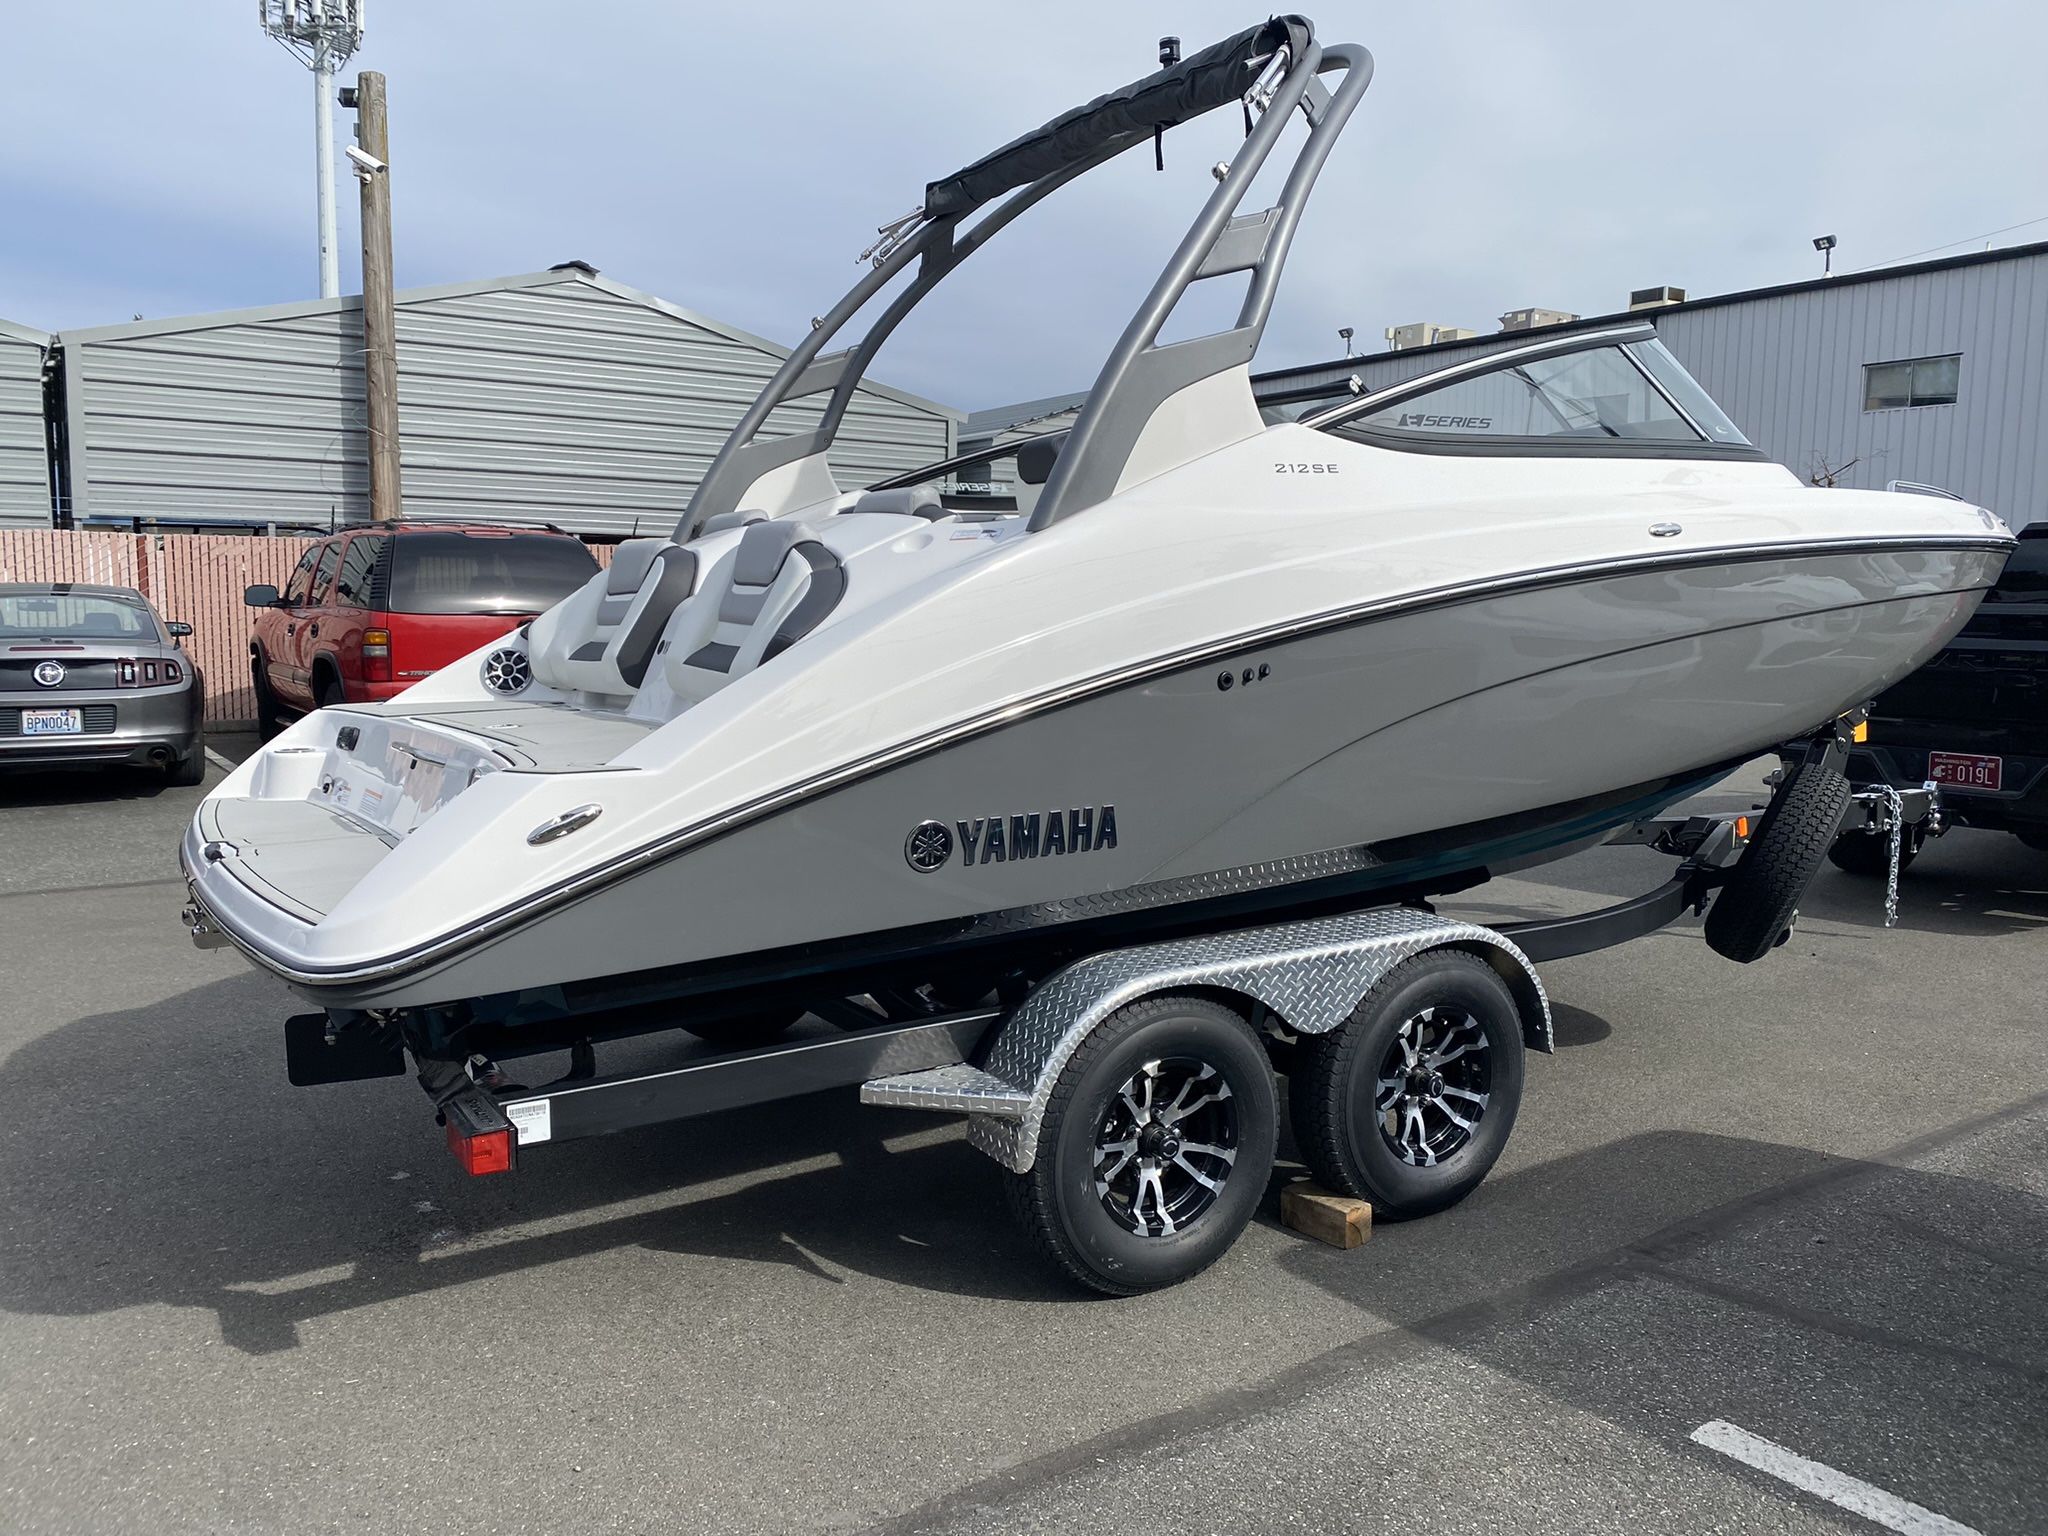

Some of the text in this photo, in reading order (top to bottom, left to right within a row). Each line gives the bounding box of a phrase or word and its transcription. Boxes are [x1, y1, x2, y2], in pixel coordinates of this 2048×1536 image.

[1423, 415, 1492, 429] SERIES
[1275, 463, 1339, 474] 212SE
[27, 716, 77, 730] BPN0047
[1957, 765, 1993, 785] 019L
[957, 804, 1117, 866] YAMAHA
